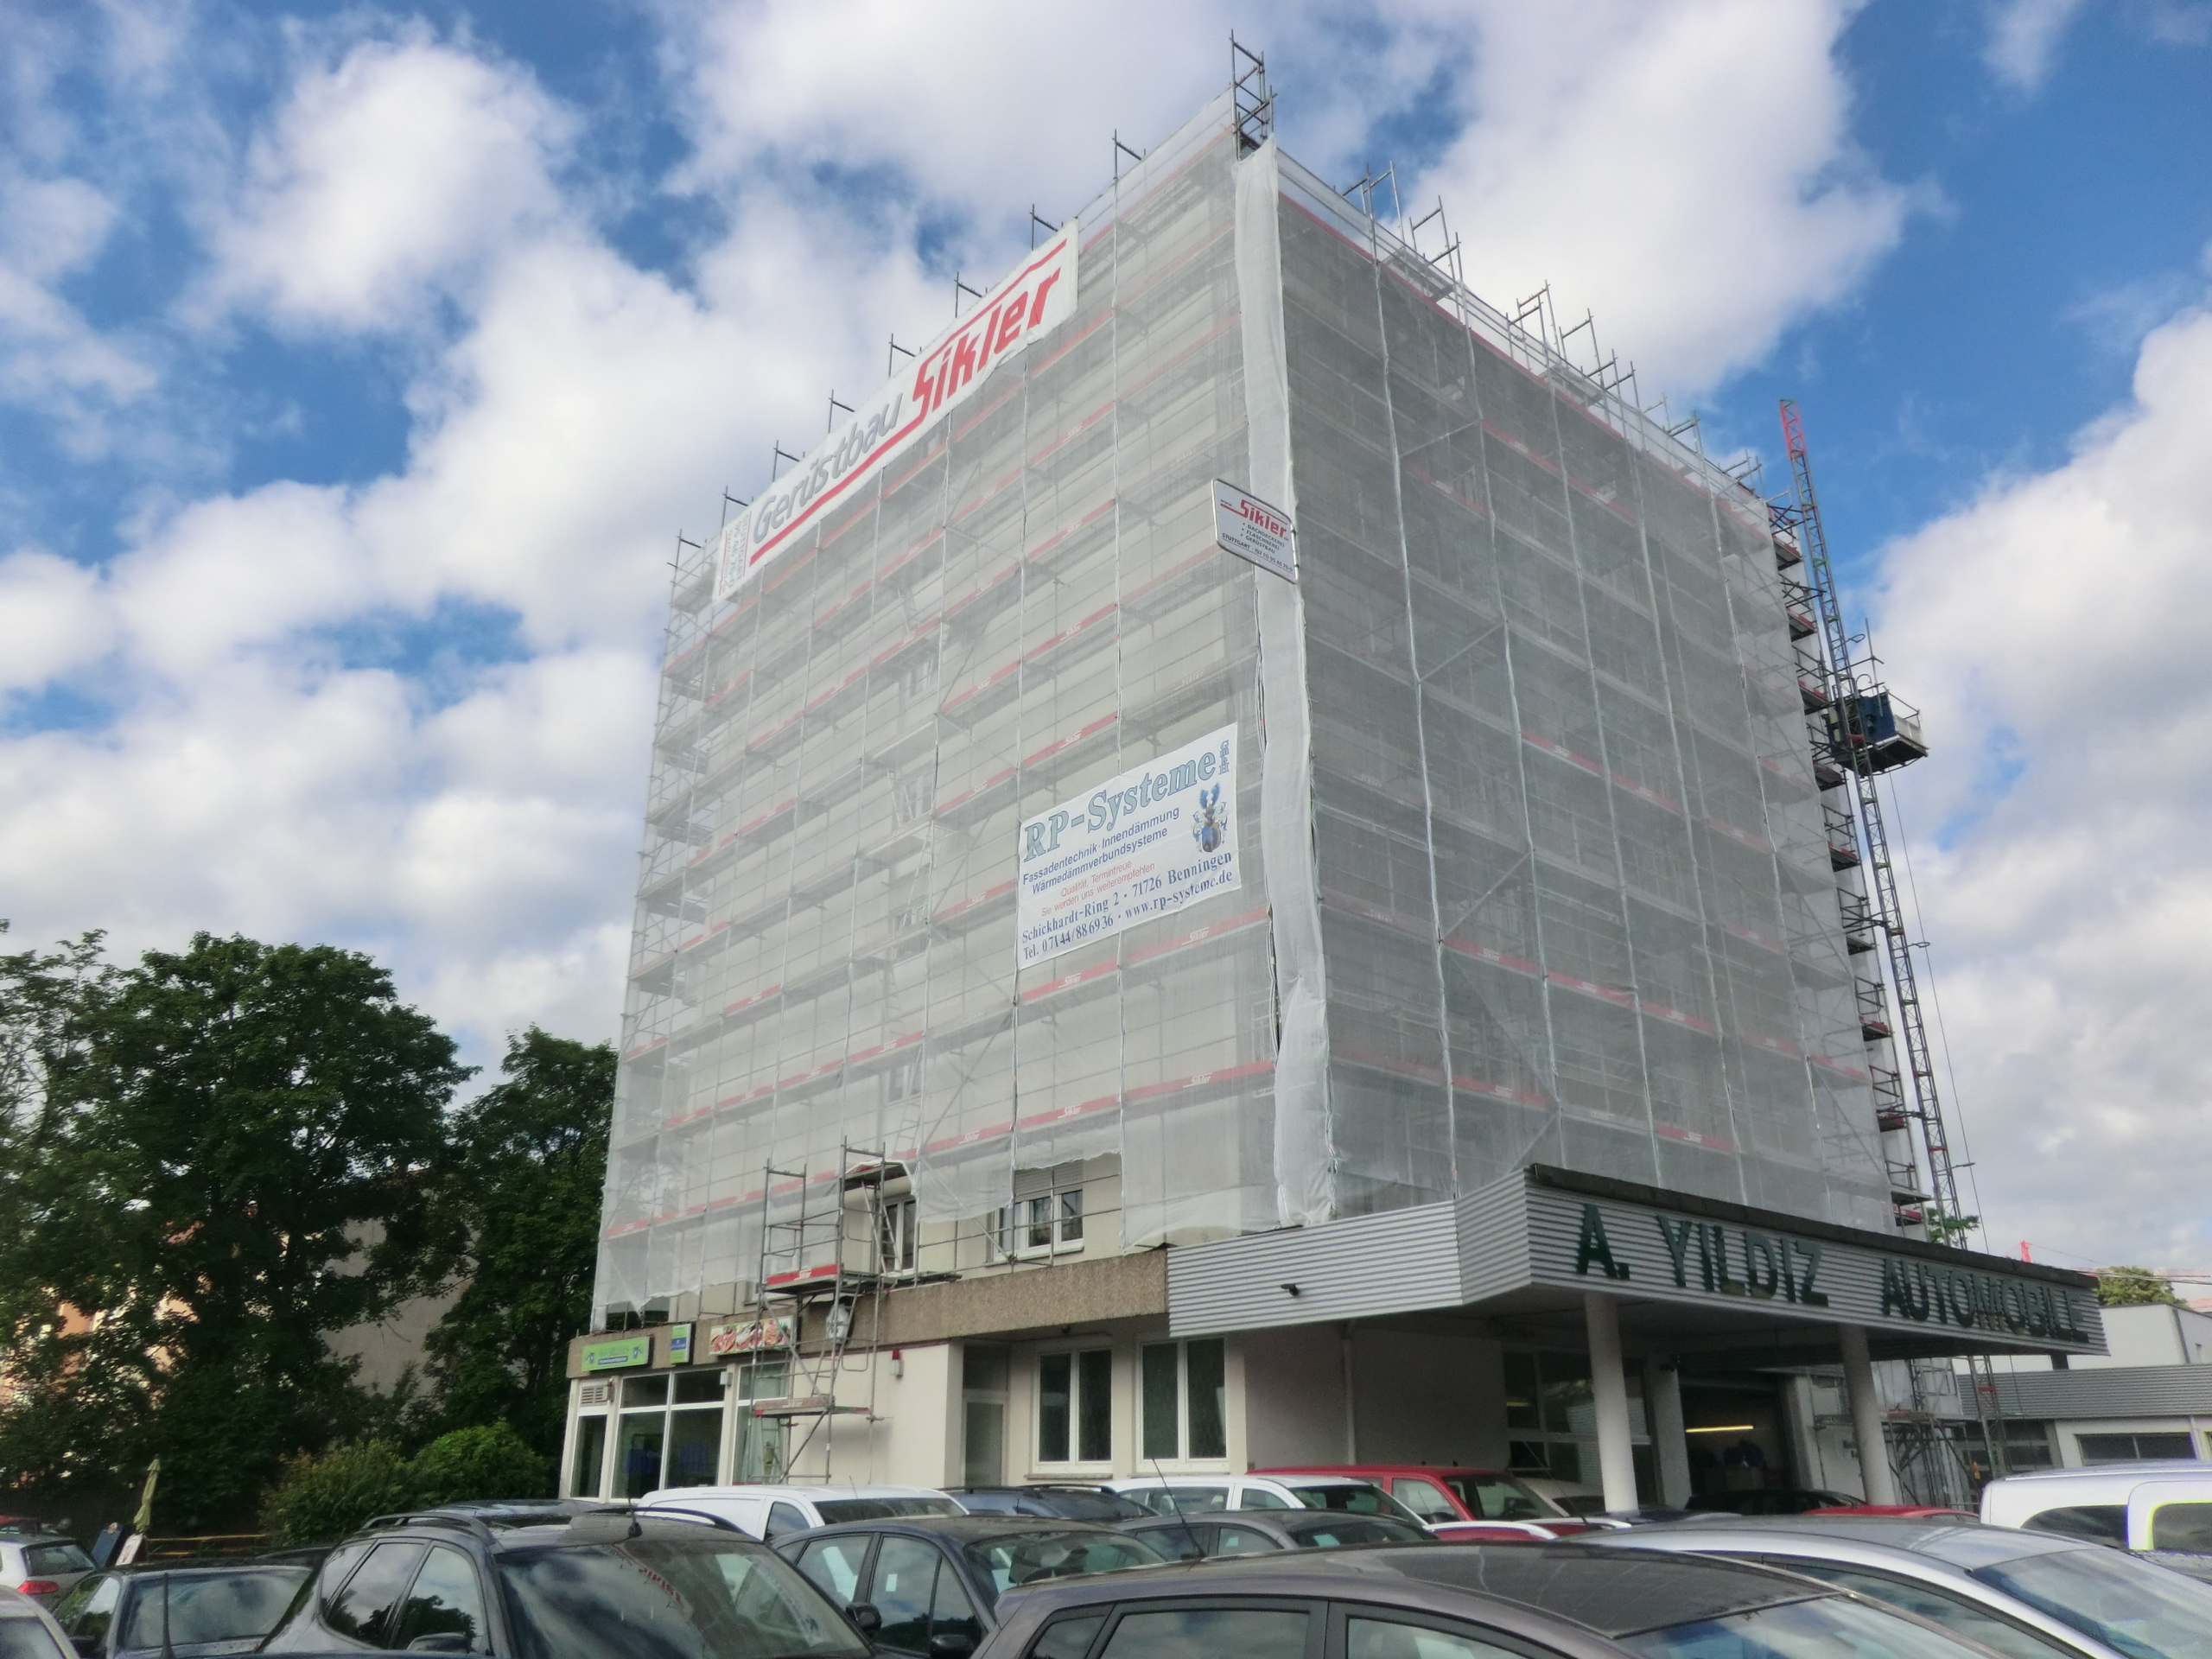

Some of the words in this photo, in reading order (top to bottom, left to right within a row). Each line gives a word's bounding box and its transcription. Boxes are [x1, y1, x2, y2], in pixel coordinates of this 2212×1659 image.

[753, 392, 903, 544] Gerüstbau
[912, 266, 1061, 423] Sikler
[1222, 532, 1250, 550] STUTTGART
[1240, 499, 1287, 537] Sikler
[1245, 534, 1275, 554] GERÜSTBAU
[1246, 530, 1280, 550] FLASCHNEREI
[1247, 524, 1285, 548] DACHDECKEREI
[1023, 751, 1217, 862] RP-Systeme
[1022, 844, 1098, 885] Fassadentechnik
[1102, 807, 1180, 849] Innendämmung
[1032, 827, 1168, 894] Wärmedämmverbundsysteme
[1022, 898, 1109, 944] Schickhardt-Ring
[1113, 892, 1120, 906] 2
[1132, 874, 1162, 898] 71726
[1167, 852, 1232, 885] Benningen
[1041, 906, 1052, 917] Sie
[1054, 895, 1079, 912] werden
[1081, 888, 1094, 902] uns
[1096, 862, 1155, 896] weiterempfehlen
[1061, 880, 1089, 897] Qualität,
[1091, 861, 1132, 885] Termintreue
[1023, 944, 1039, 960] Tel.
[1125, 869, 1233, 918] www.rp-systeme.de
[1656, 1214, 1828, 1307] YILDIZ
[1881, 1257, 2089, 1344] AUTOMOBILE
